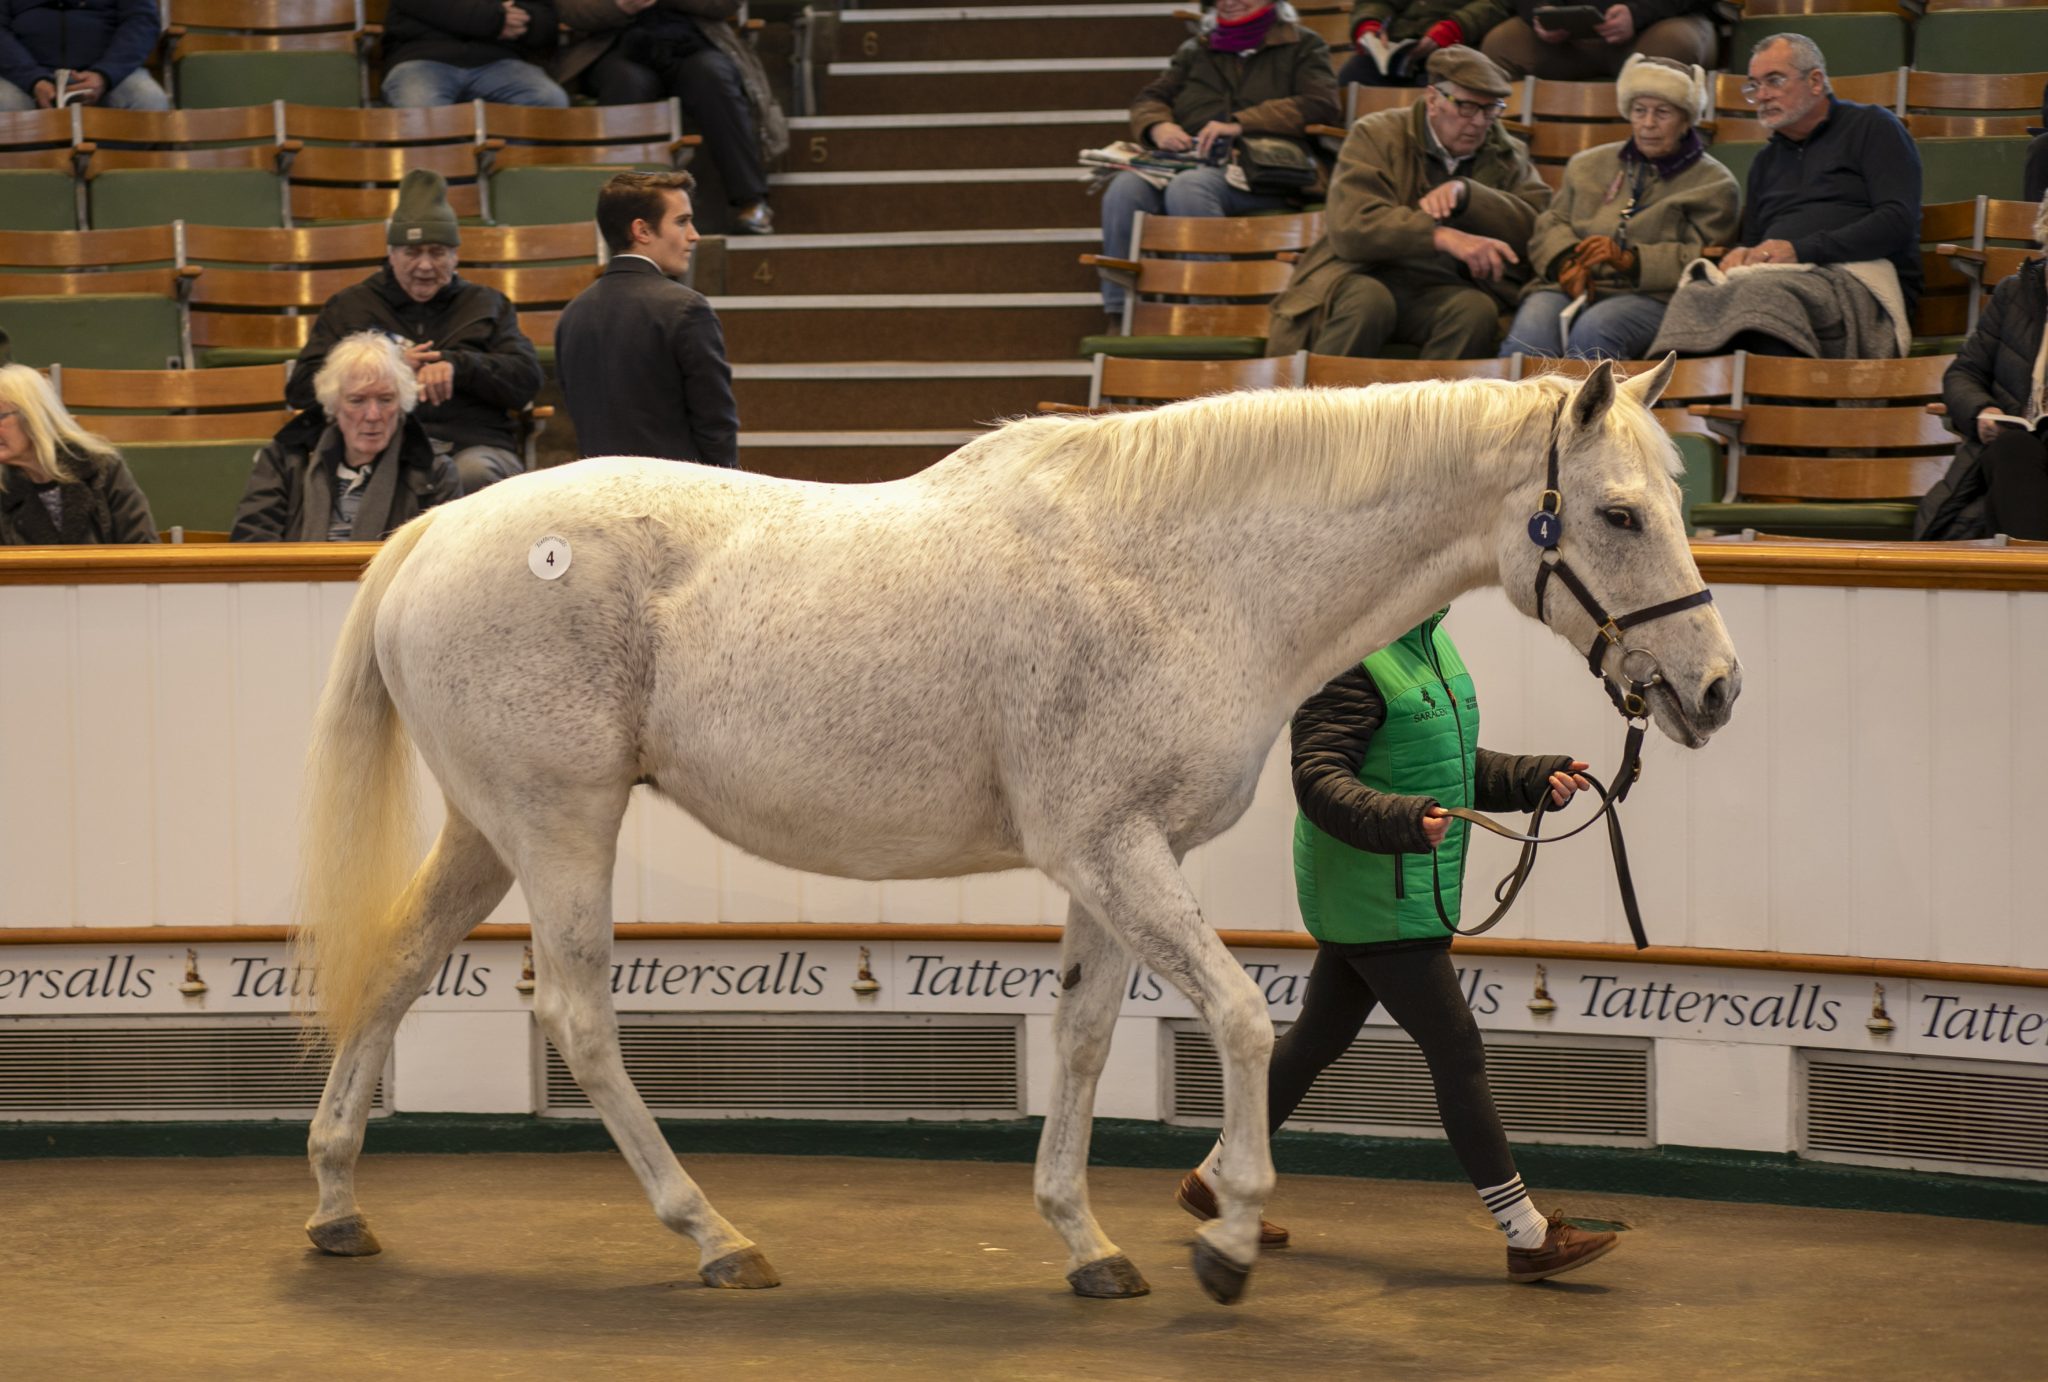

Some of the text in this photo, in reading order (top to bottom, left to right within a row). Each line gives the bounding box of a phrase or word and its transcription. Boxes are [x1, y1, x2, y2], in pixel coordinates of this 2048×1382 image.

[862, 31, 879, 56] 6
[809, 137, 828, 163] 5
[753, 261, 774, 284] 4
[1541, 520, 1548, 539] 4
[546, 550, 555, 567] 4
[611, 951, 828, 996] attersalls
[1580, 974, 1842, 1032] Tattersalls
[1921, 994, 2048, 1046] Tatte
